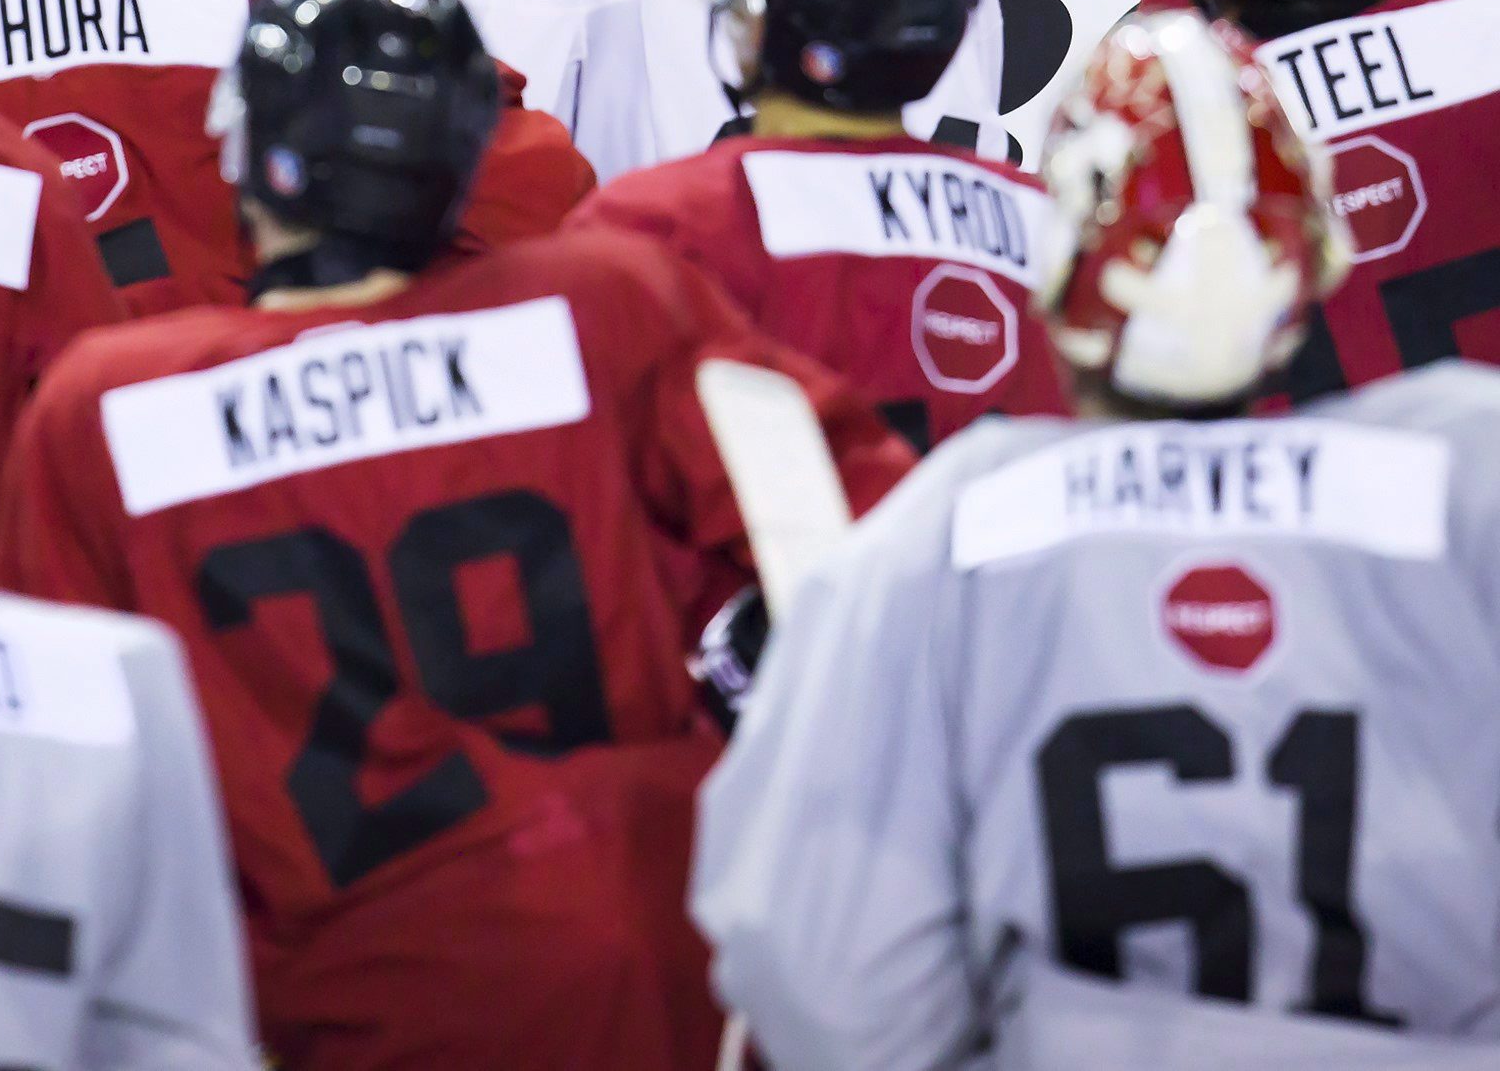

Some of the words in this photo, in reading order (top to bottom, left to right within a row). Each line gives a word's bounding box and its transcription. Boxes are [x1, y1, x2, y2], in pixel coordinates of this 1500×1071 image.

[1277, 25, 1435, 128] TEEL
[60, 152, 108, 179] PECT
[1333, 177, 1404, 216] ESPECT
[868, 168, 1028, 268] KYROU
[216, 333, 488, 473] KASPICK
[1063, 438, 1322, 522] HARVEY
[197, 487, 614, 890] 29
[1038, 704, 1408, 1028] 61
